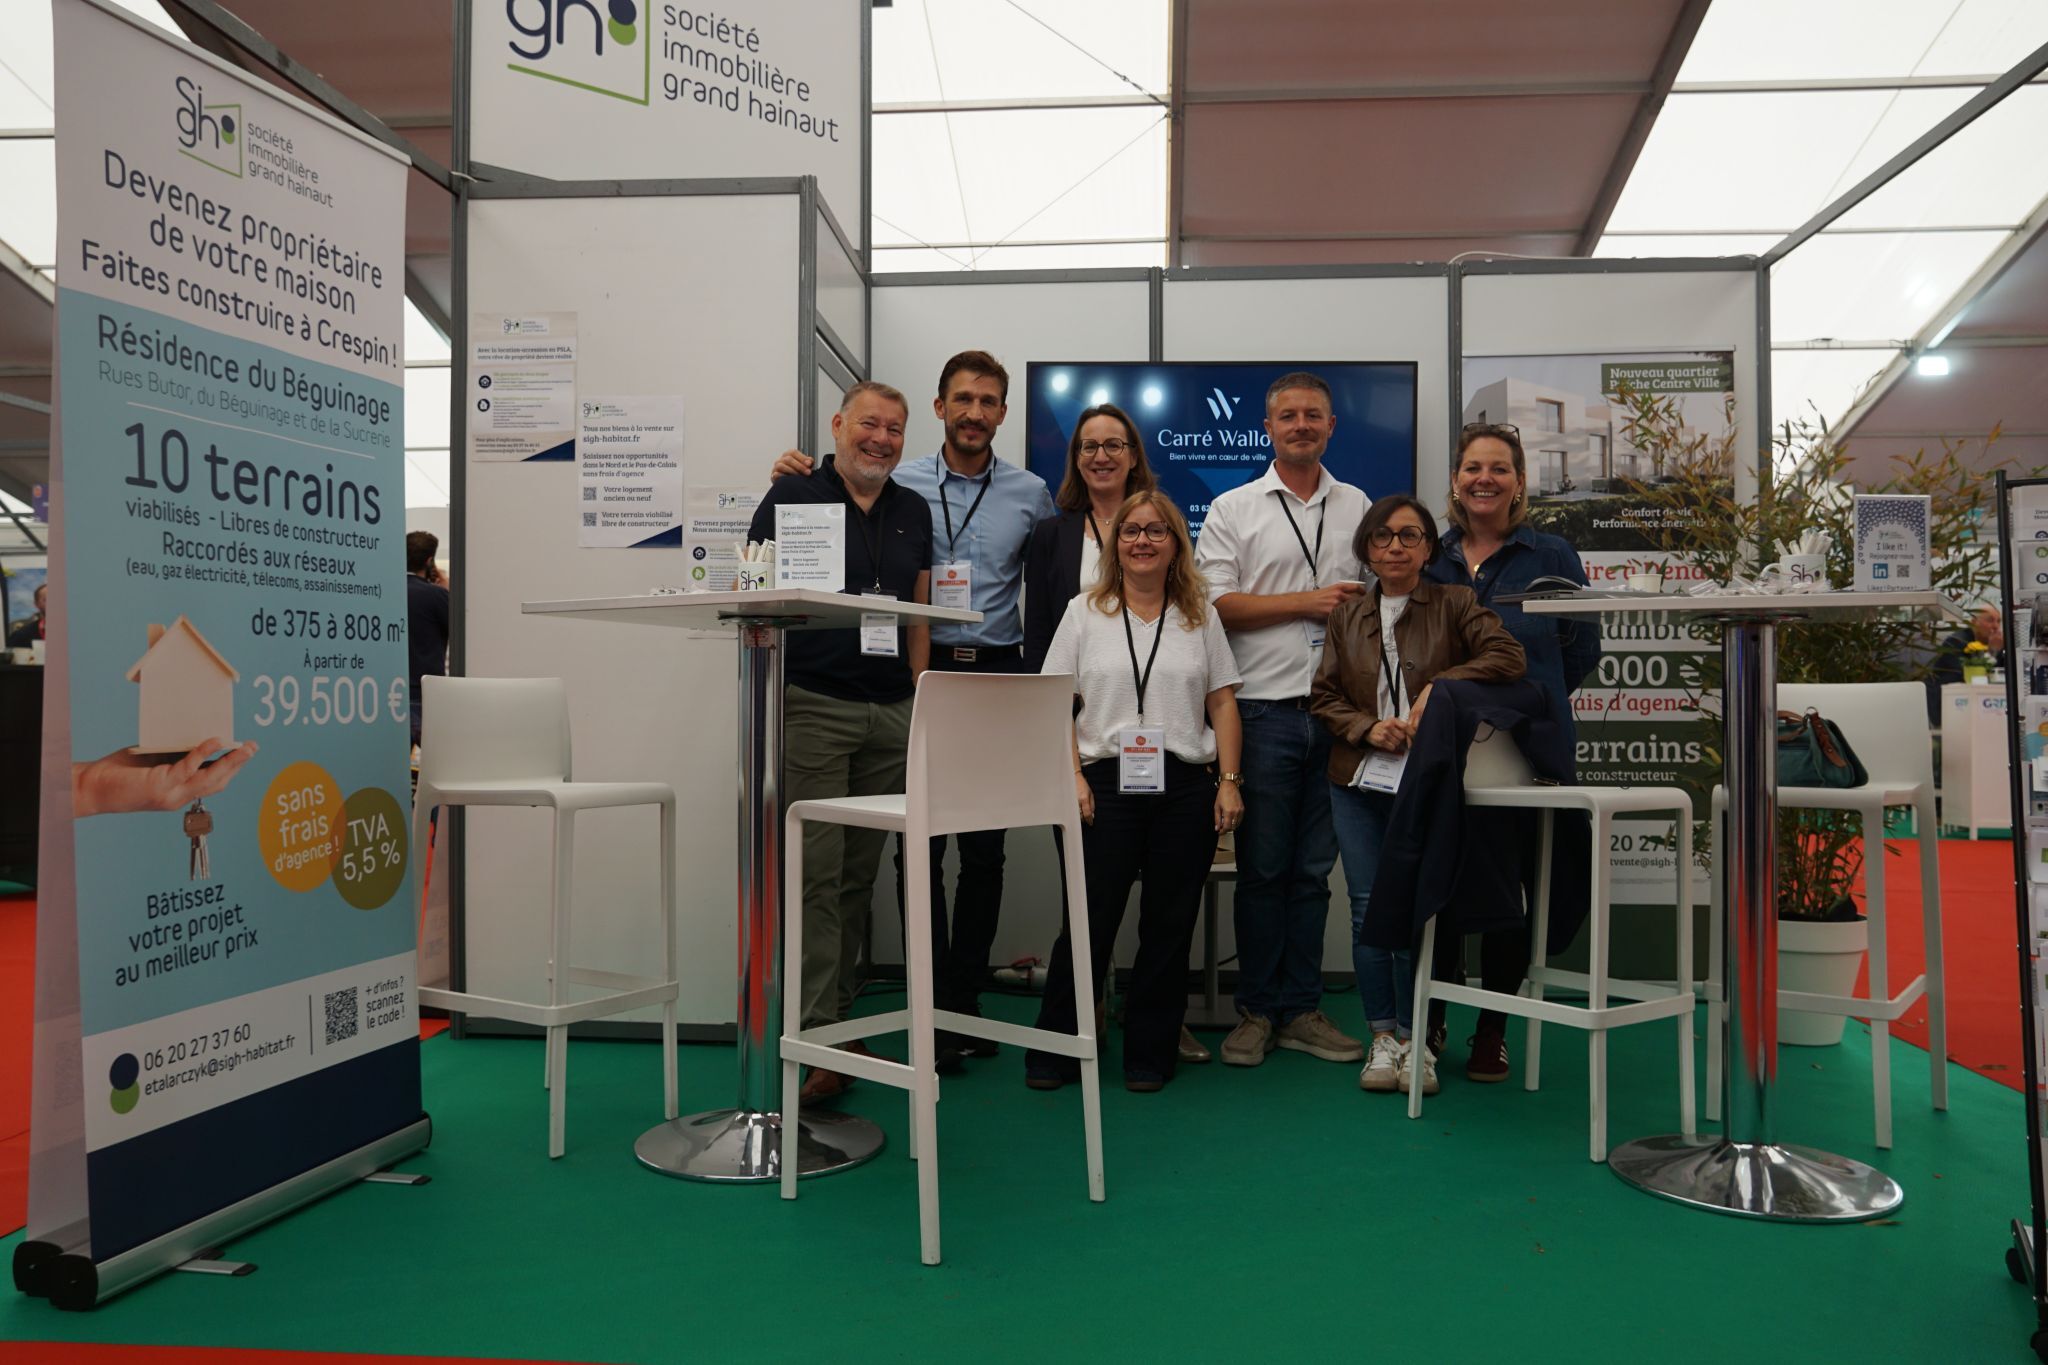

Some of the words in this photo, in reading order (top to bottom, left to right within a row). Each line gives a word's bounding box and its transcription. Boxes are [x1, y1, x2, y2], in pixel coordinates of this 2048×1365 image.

[663, 3, 760, 53] société
[663, 32, 811, 102] immobilière
[663, 72, 740, 112] grand
[748, 90, 839, 142] hainaut
[247, 121, 294, 154] société
[247, 140, 319, 184] immobilière
[248, 159, 285, 186] grand
[287, 176, 334, 208] hainaut
[104, 149, 232, 232] Devenez
[242, 214, 383, 289] propriétaire
[150, 213, 183, 253] de
[192, 234, 268, 283] votre
[275, 265, 355, 315] maison
[82, 239, 169, 295] Faites
[177, 278, 295, 336] construire
[300, 313, 312, 341] à
[317, 319, 389, 365] Crespin
[98, 314, 239, 383] Résidence
[248, 358, 276, 393] du
[283, 366, 390, 425] Béguinage
[1610, 367, 1664, 379] Nouveau
[1666, 367, 1719, 381] quartier
[1652, 378, 1692, 389] Centre
[1693, 378, 1720, 389] Ville
[98, 360, 143, 389] Rues
[148, 371, 194, 407] Butor,
[197, 385, 217, 408] du
[220, 390, 291, 427] Béguinage
[293, 406, 307, 429] et
[310, 414, 327, 434] de
[329, 417, 340, 437] la
[343, 421, 391, 449] Sucrerie
[583, 434, 641, 445] sigh-habitat.fr
[1157, 428, 1213, 447] Carré
[1217, 429, 1272, 447] Wallo
[1169, 452, 1187, 460] Bien
[125, 423, 190, 493] 10
[204, 444, 382, 525] terrains
[126, 496, 200, 526] viabilisés
[220, 510, 270, 536] Libres
[273, 518, 290, 538] de
[292, 523, 380, 551] constructeur
[720, 519, 752, 528] propriétai
[1189, 504, 1200, 512] 03
[1621, 507, 1661, 517] Confort
[162, 531, 258, 565] Raccordés
[263, 549, 290, 570] aux
[295, 550, 356, 576] réseaux
[1584, 560, 1616, 581] ire
[126, 557, 159, 579] (eau,
[162, 562, 183, 581] gaz
[185, 563, 250, 587] électricité,
[304, 578, 382, 599] assainissement)
[252, 607, 278, 636] de
[283, 609, 321, 639] 375
[327, 613, 338, 640] à
[344, 613, 382, 641] 808
[314, 652, 348, 672] partir
[351, 654, 365, 669] de
[253, 674, 379, 727] 39.500
[388, 677, 407, 723] €
[1574, 733, 1702, 764] errains
[1585, 770, 1678, 782] constructeur
[276, 783, 325, 816] sans
[279, 811, 329, 848] frais
[347, 812, 390, 847] TVA
[274, 843, 332, 873] d'agence
[343, 846, 377, 882] 5,5
[381, 839, 400, 868] %
[146, 883, 225, 920] Bâtissez
[128, 920, 183, 954] votre
[188, 903, 245, 943] projet
[115, 962, 140, 987] au
[146, 938, 218, 978] meilleur
[225, 926, 259, 960] prix
[366, 989, 405, 1014] scannez
[373, 977, 399, 995] d'infos
[366, 1015, 375, 1030] le
[377, 1008, 401, 1027] code
[143, 1050, 164, 1071] 06
[167, 1043, 186, 1065] 20
[189, 1035, 208, 1057] 27
[211, 1029, 230, 1051] 37
[232, 1023, 252, 1044] 60
[144, 1034, 296, 1096] etalarczyk@sigh-habitat.fr
